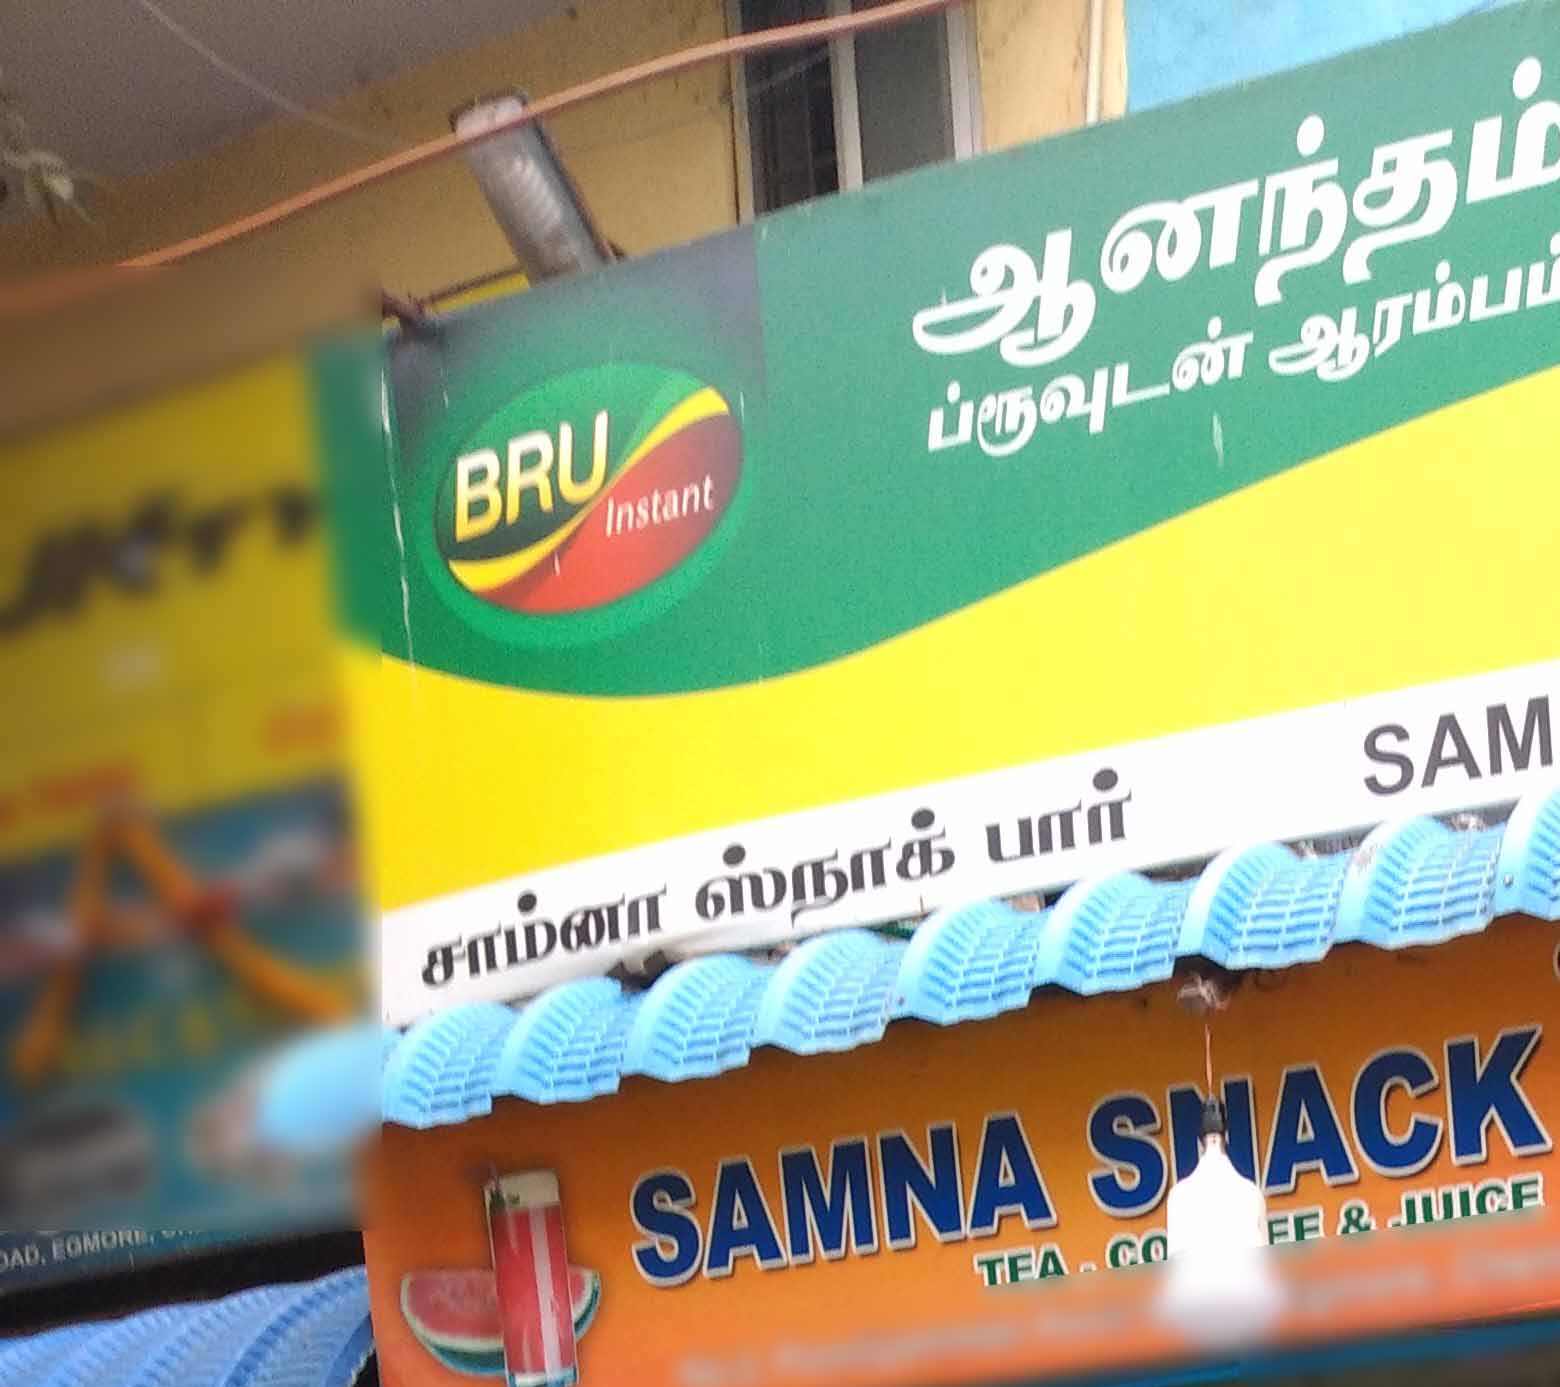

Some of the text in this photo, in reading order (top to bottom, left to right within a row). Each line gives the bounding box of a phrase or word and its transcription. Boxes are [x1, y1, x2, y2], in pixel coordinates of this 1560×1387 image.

[927, 316, 1254, 457] ப்ரூவுடன்
[454, 410, 609, 545] BRU
[604, 475, 715, 538] Instant
[420, 767, 1133, 987] சாம்னா ஸ்நாக் பார்
[630, 1112, 1058, 1286] SAMNA
[1088, 1024, 1556, 1218] SNACK
[1388, 1172, 1545, 1228] JUICE
